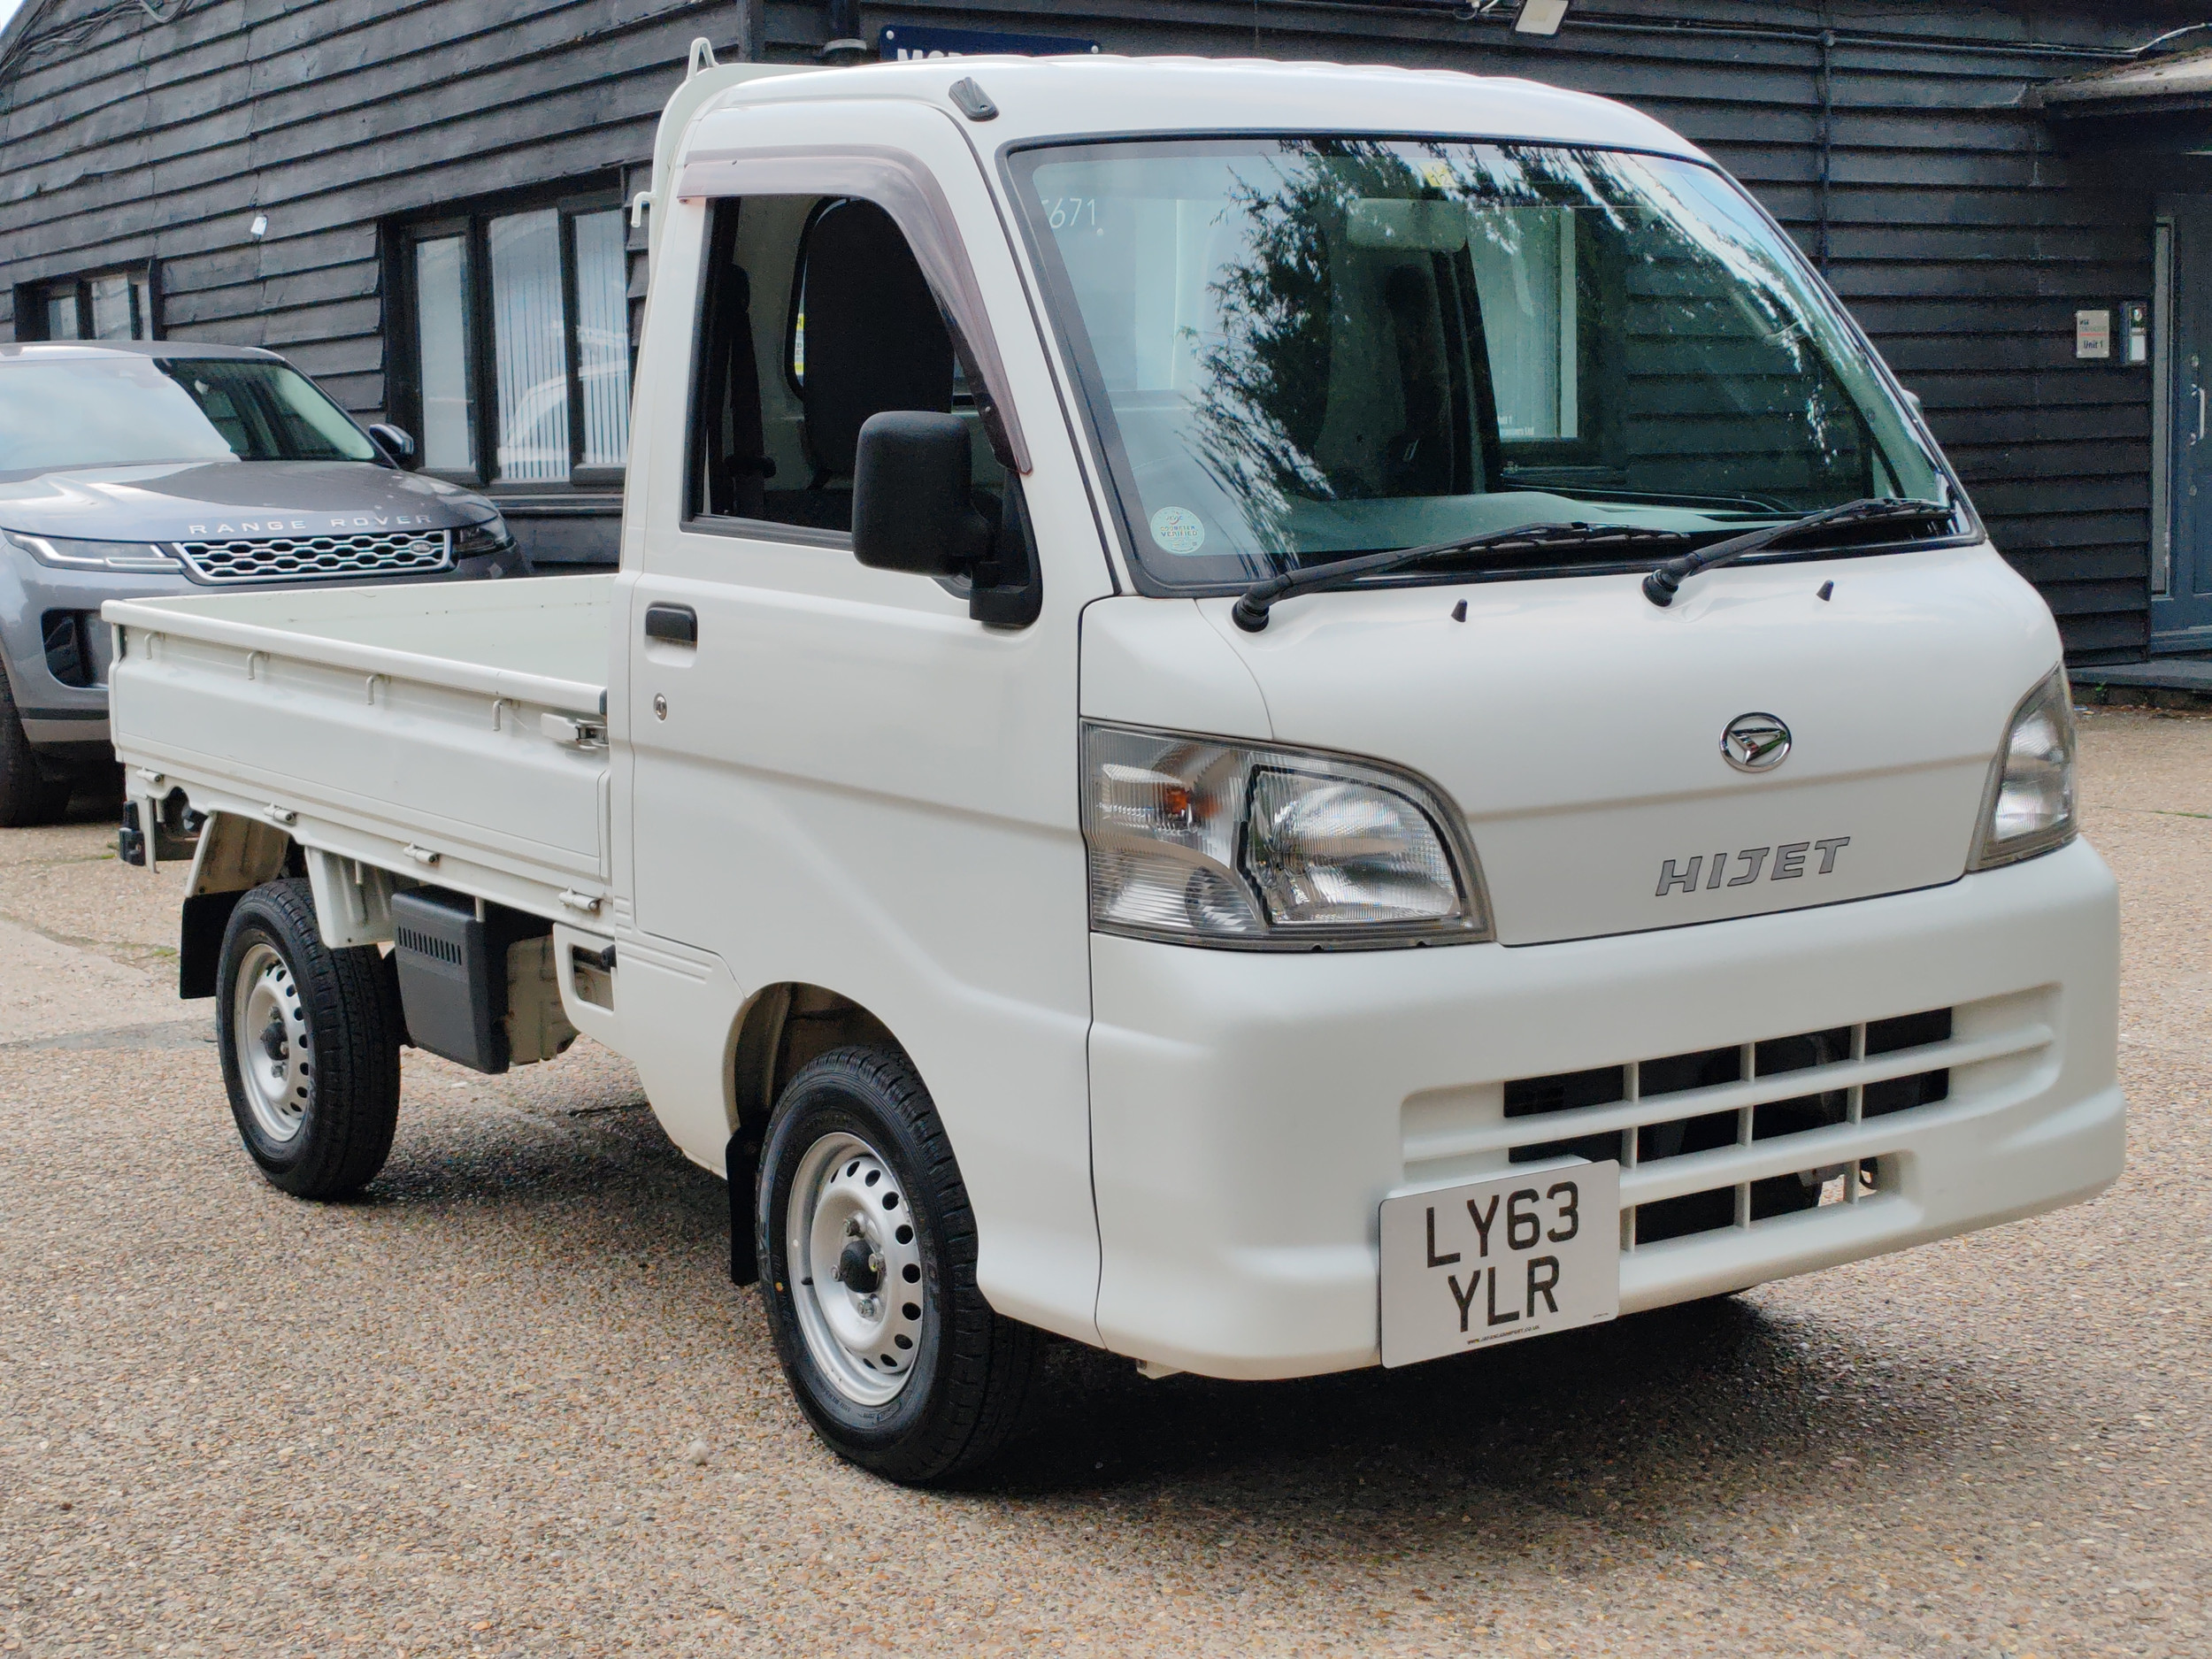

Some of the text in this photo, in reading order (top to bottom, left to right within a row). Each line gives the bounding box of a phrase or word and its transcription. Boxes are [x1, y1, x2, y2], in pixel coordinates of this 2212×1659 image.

[1041, 197, 1095, 229] 671
[2083, 340, 2098, 349] Unit
[188, 514, 433, 534] RANGE ROVER
[1655, 836, 1851, 896] HIJET
[1426, 1181, 1578, 1268] LY63
[1448, 1256, 1559, 1333] YLR
